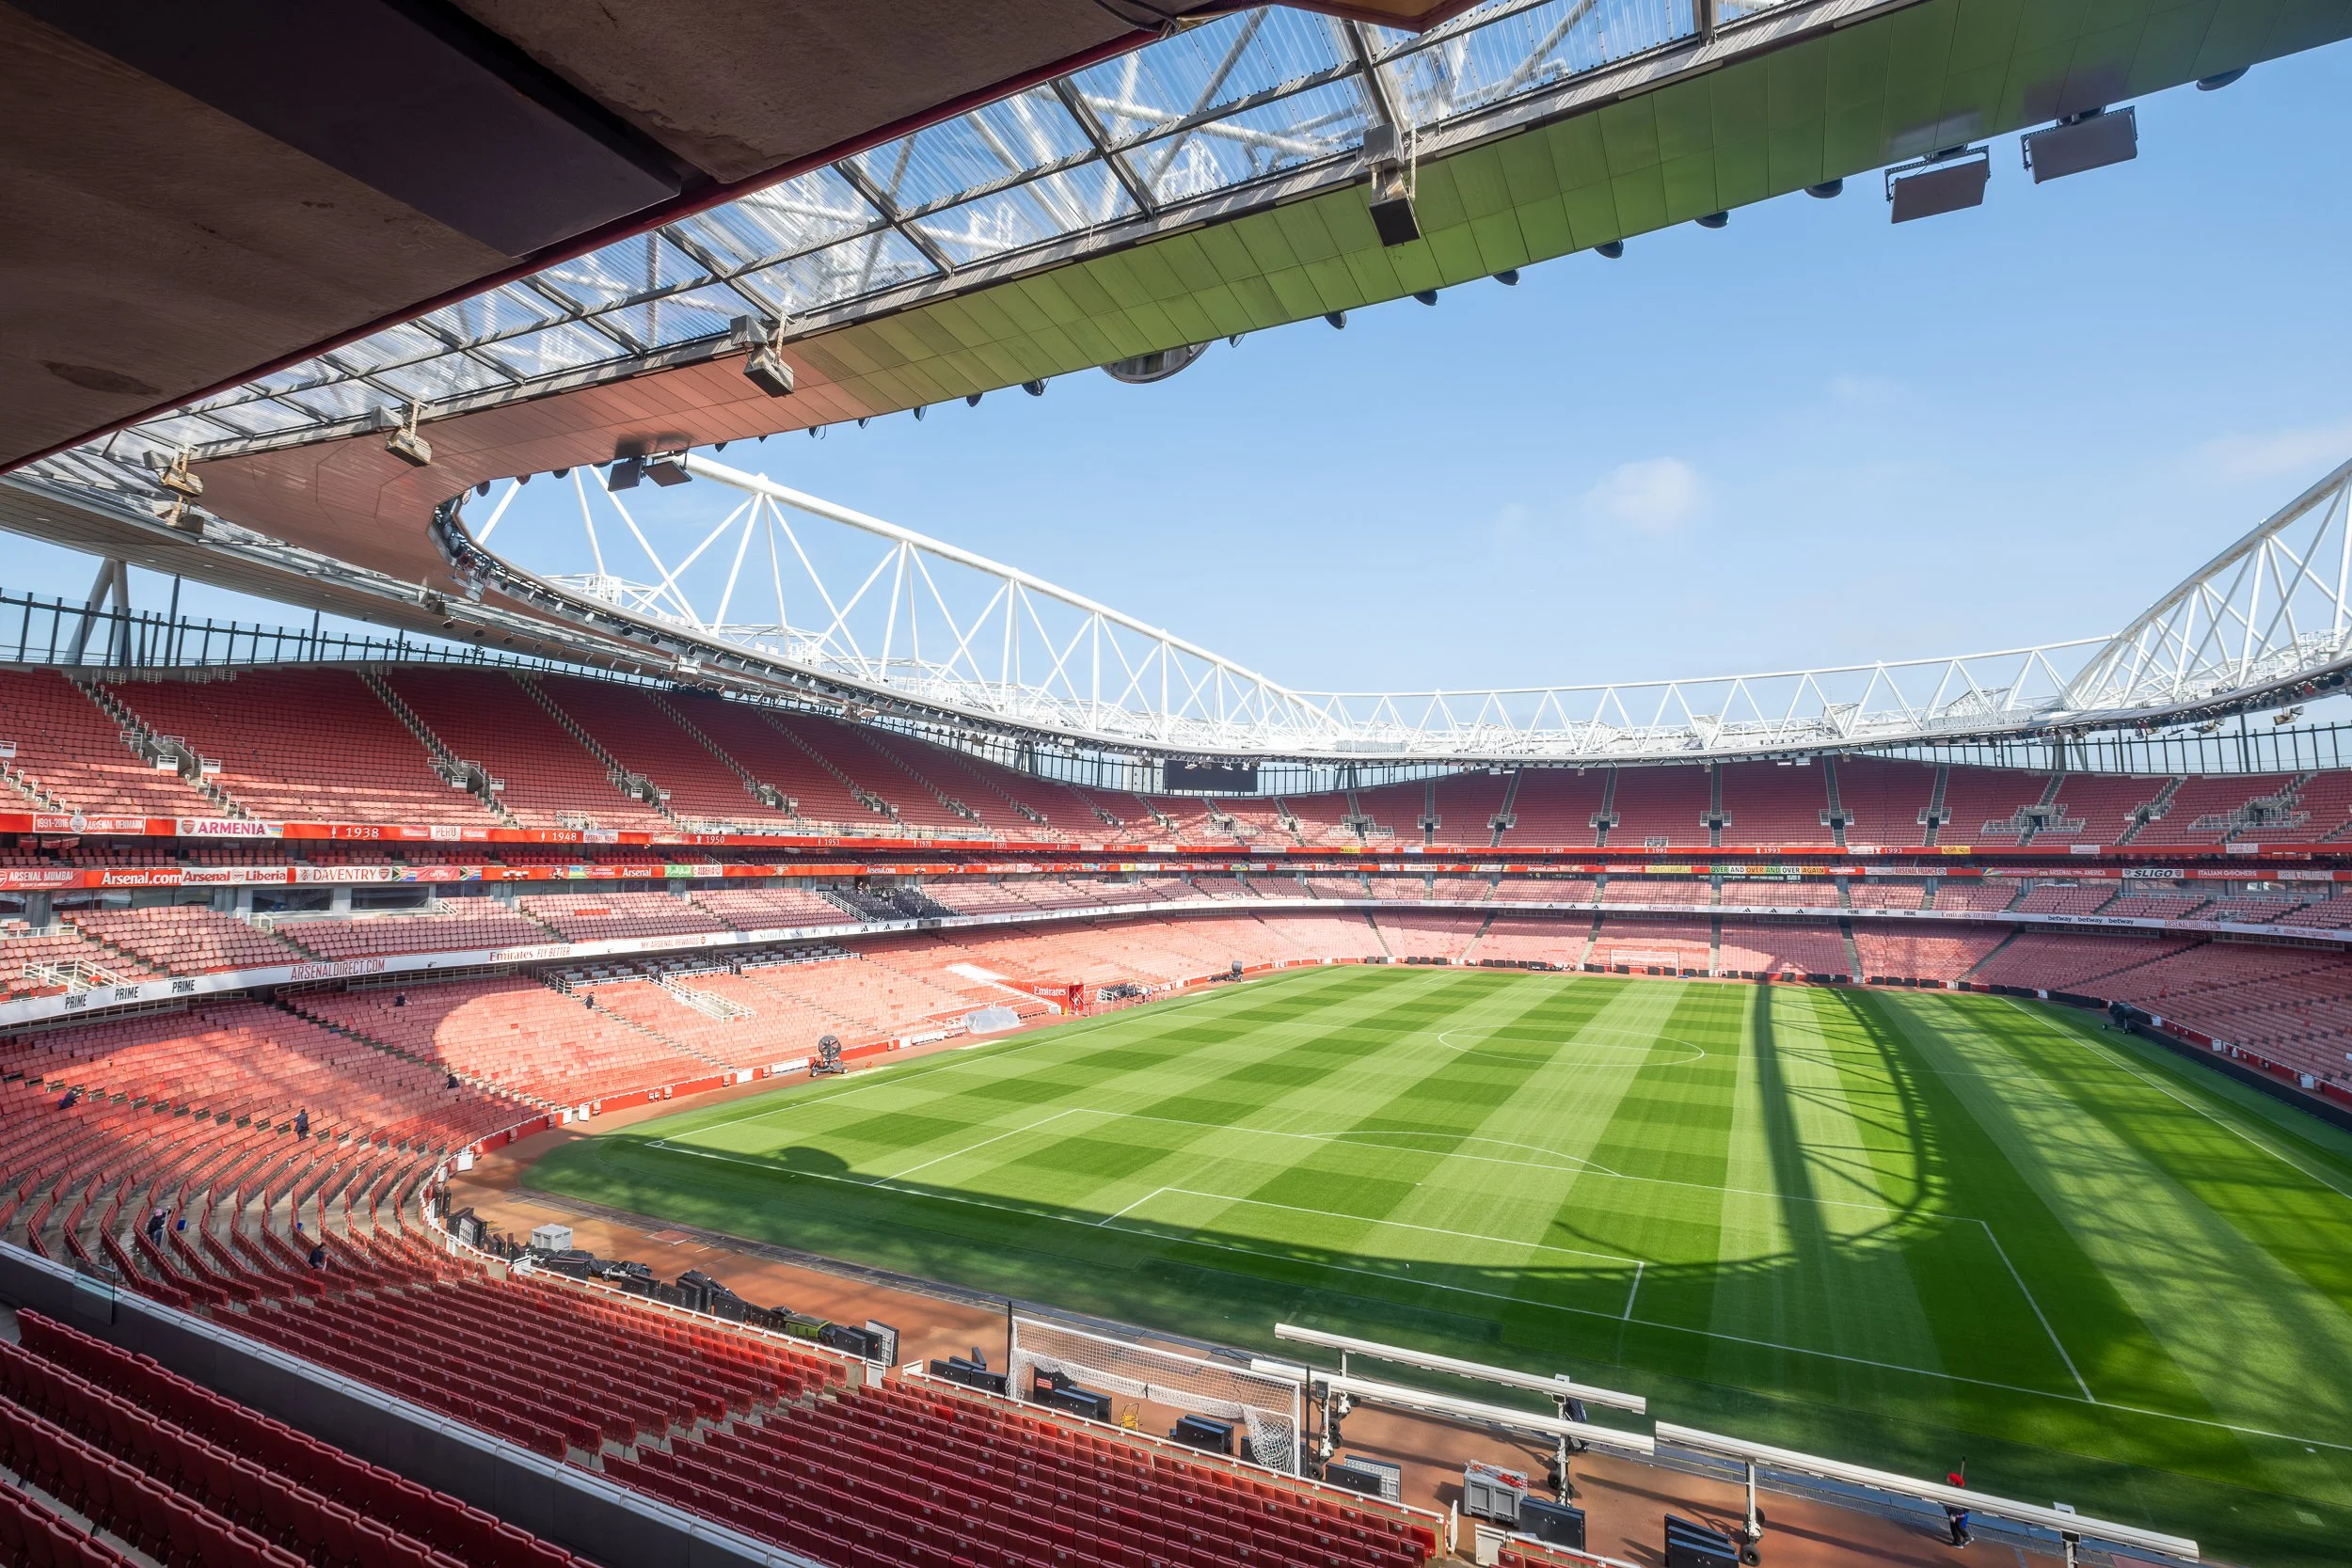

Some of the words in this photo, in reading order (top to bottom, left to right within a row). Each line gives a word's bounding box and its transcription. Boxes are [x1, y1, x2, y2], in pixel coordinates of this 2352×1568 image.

[37, 817, 69, 829] 1991-2016
[87, 820, 114, 831] ARSENAL
[116, 819, 143, 830] DENMARK
[198, 821, 265, 835] ARMENIA
[345, 827, 379, 838] 1938
[436, 827, 456, 836] PERU
[552, 832, 577, 841] 1948
[706, 835, 724, 844] 1950
[313, 868, 376, 880] DAVENTRY
[622, 867, 652, 878] Arsenal
[866, 865, 897, 874] Arsenal.com
[2134, 869, 2173, 878] SLIGO
[8, 871, 41, 881] ARSENAL
[43, 871, 73, 880] MUMBAI
[101, 871, 182, 885] Arsenal.com
[183, 870, 230, 882] Arsenal
[246, 870, 286, 881] Liberia
[2164, 920, 2221, 931] ARSENALDIRECT.COM
[649, 940, 674, 948] ARSENAL
[489, 950, 533, 962] Emirates
[536, 948, 548, 958] FLY
[548, 946, 571, 957] BETTER
[291, 959, 385, 981] ARSENALDIRECT.COM
[171, 979, 196, 993] PRIME
[1034, 985, 1067, 997] Emirates
[115, 986, 139, 1001] PRIME
[65, 993, 87, 1010] PRIME
